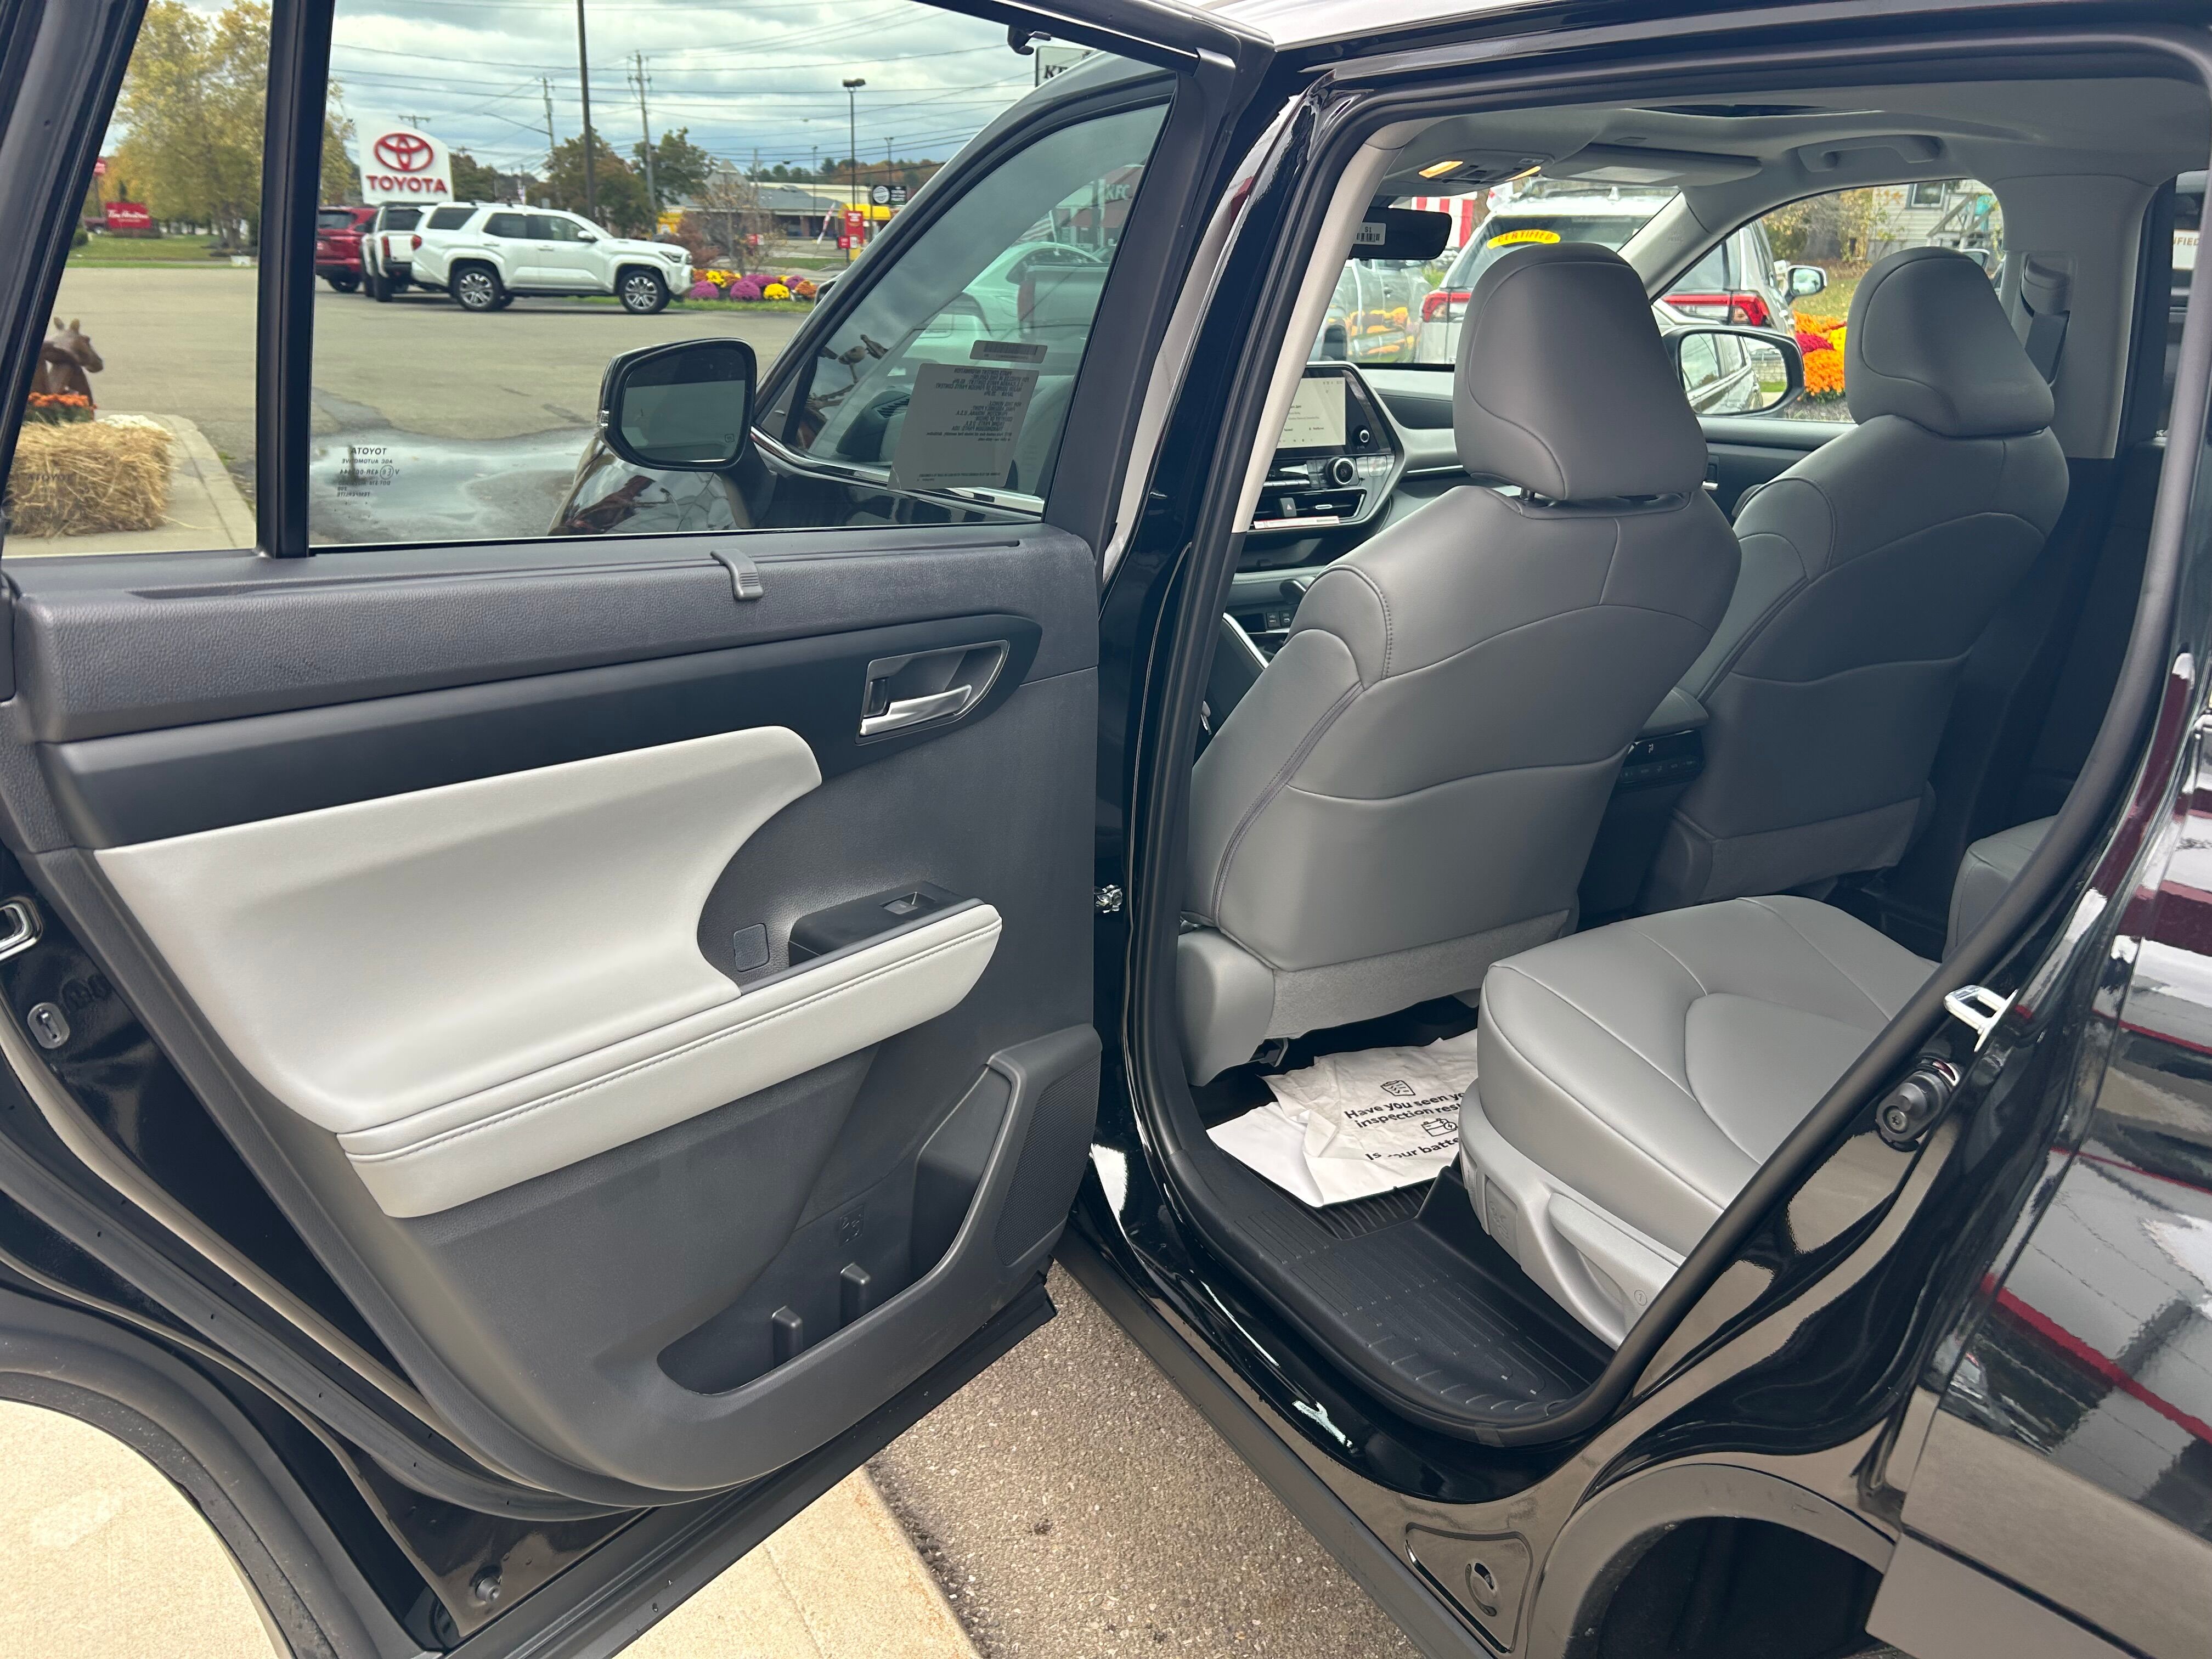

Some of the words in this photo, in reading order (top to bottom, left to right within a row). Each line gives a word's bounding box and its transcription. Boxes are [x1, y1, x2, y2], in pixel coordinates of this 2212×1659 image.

[365, 175, 447, 193] TOYOTA
[1105, 184, 1130, 200] KFC
[1498, 230, 1554, 242] CERTIFIED
[1344, 1105, 1384, 1119] Have
[1384, 1102, 1413, 1111] you
[1413, 1095, 1448, 1106] seen
[1355, 1108, 1434, 1128] inspection
[1365, 1152, 1382, 1160] Is
